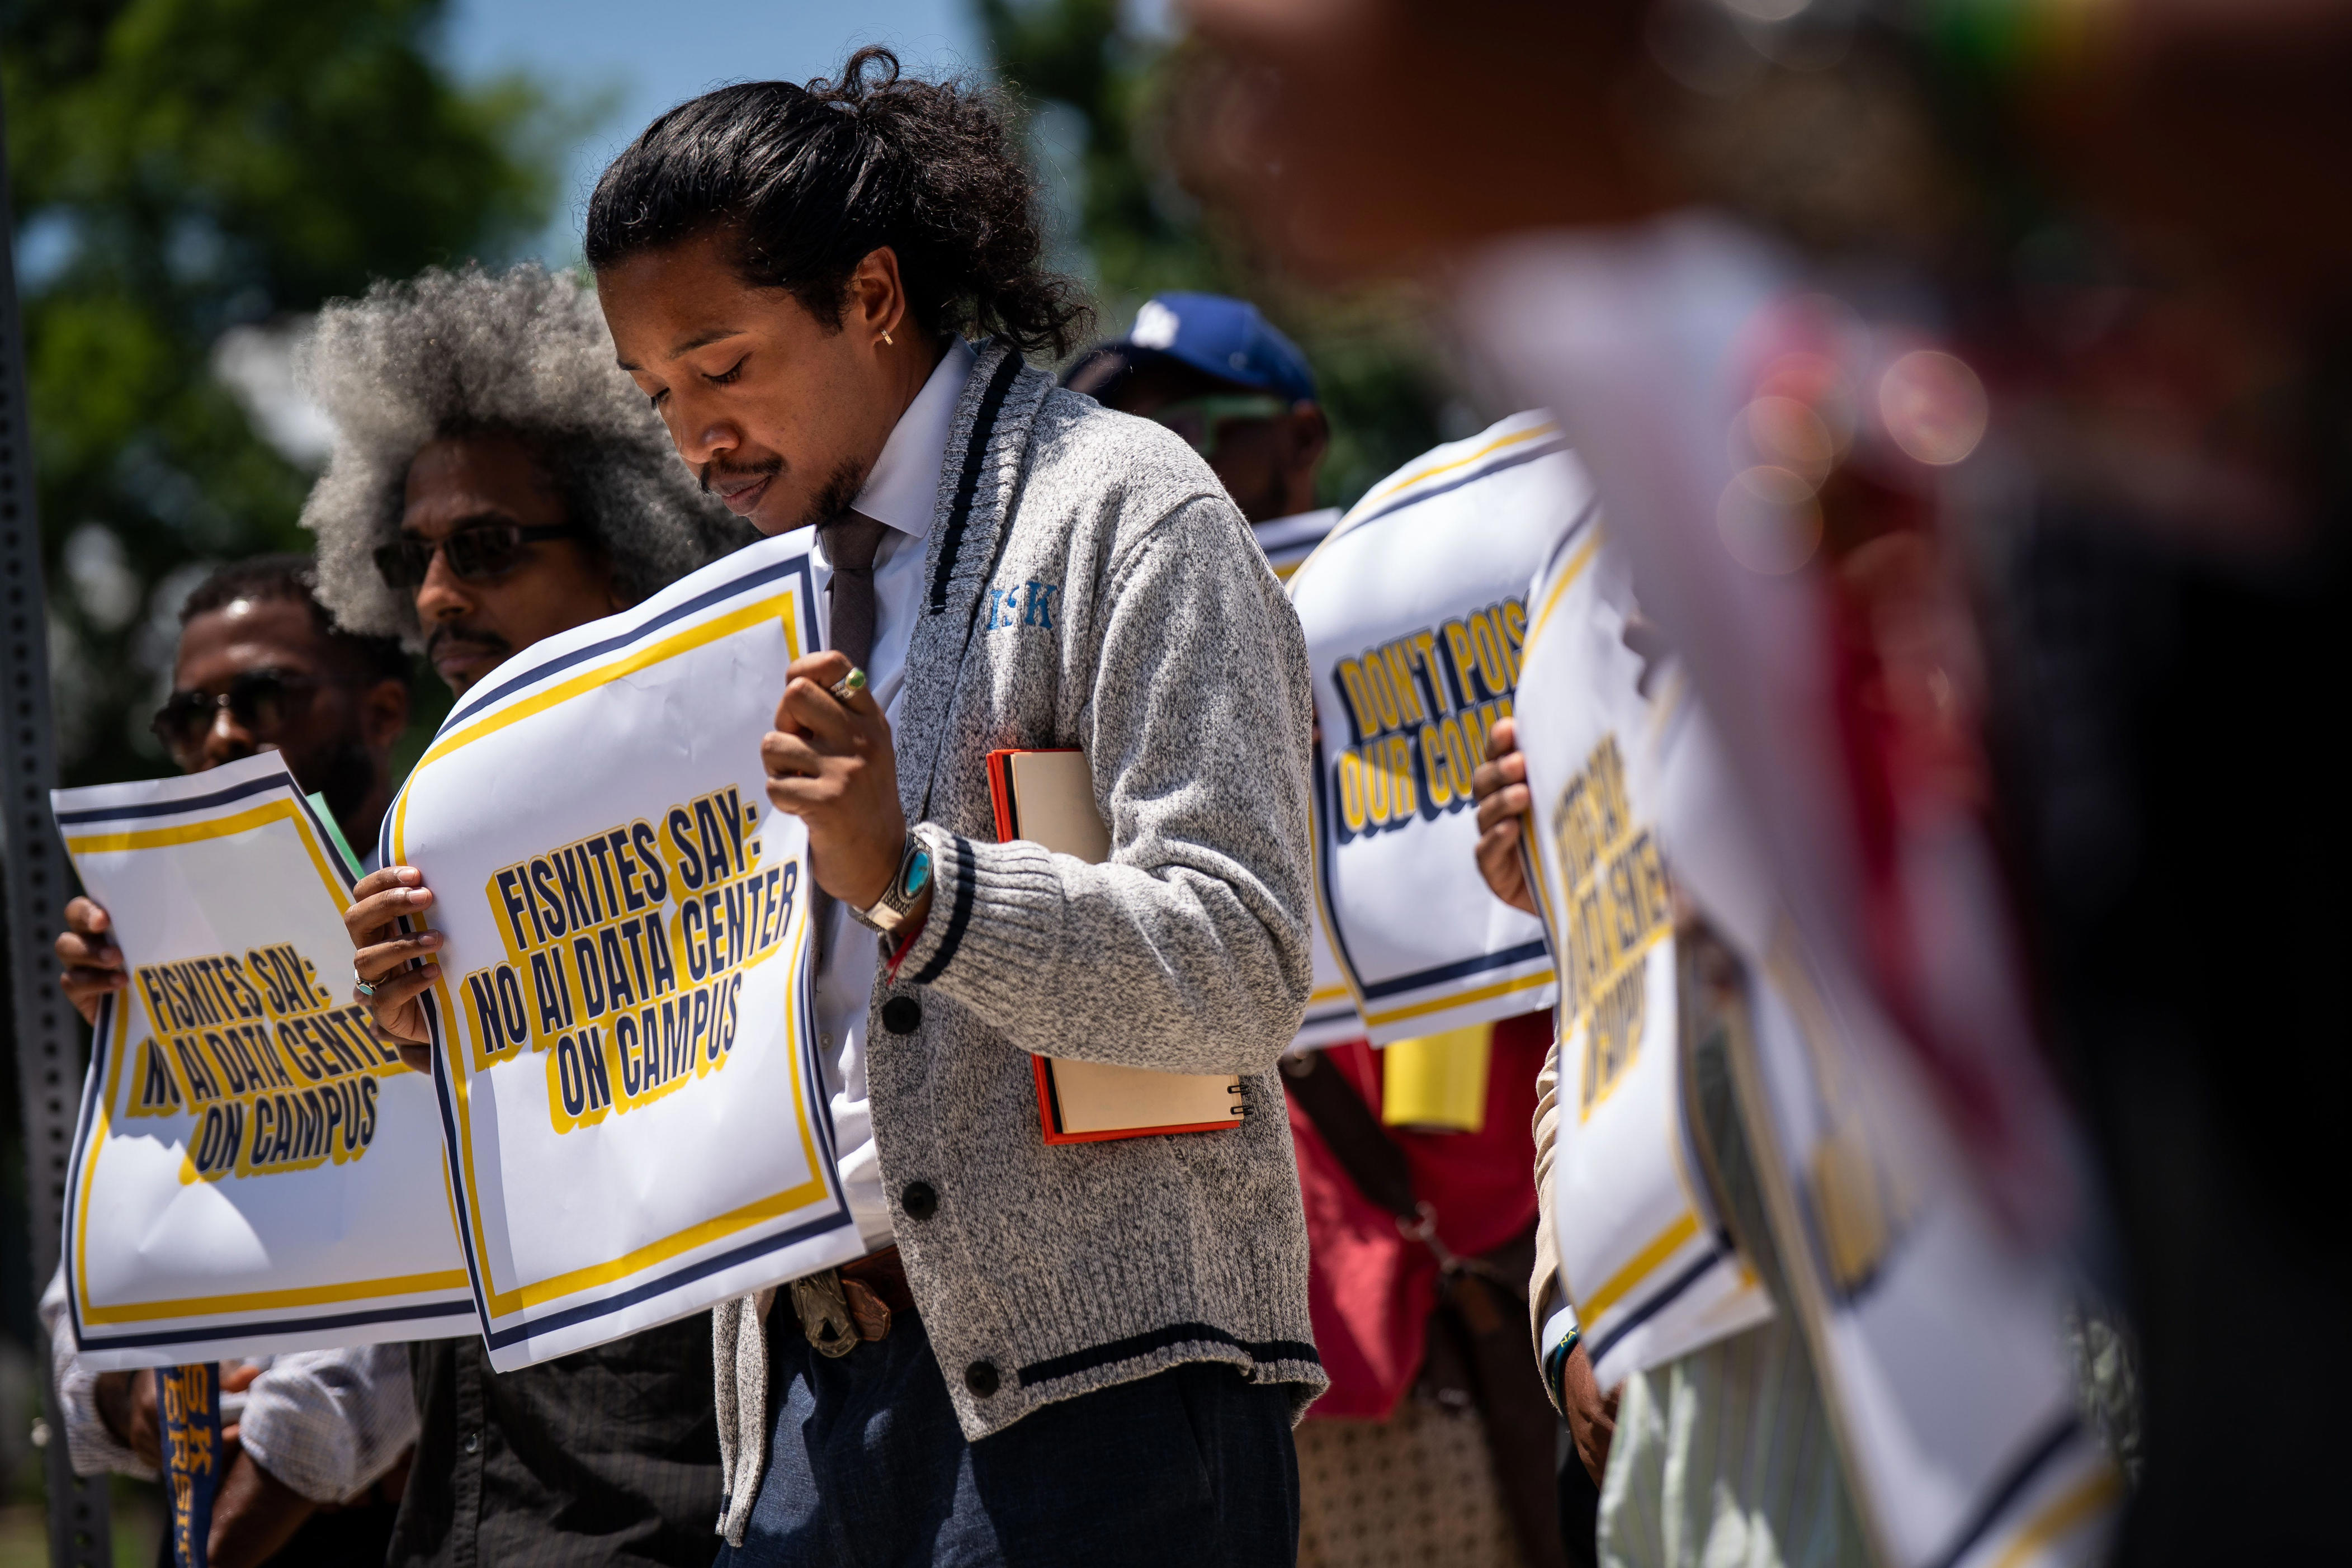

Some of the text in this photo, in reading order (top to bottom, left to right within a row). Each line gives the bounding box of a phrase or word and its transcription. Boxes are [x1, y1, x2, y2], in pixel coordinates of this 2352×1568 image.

[1339, 595, 1529, 738] DON'T POIS
[1339, 698, 1513, 832] OUR COM
[496, 788, 761, 950] FISKITES SAY:
[140, 946, 329, 1031] FISKITES SAY:
[468, 861, 797, 1054] NO AI DATA CENTER
[173, 1035, 220, 1100] AI
[205, 1024, 295, 1093] DATA
[277, 1004, 400, 1080] CENTE
[558, 973, 742, 1116] ON CAMPUS
[197, 1077, 378, 1172] ON CAMPUS
[164, 1366, 193, 1565] ERSIT
